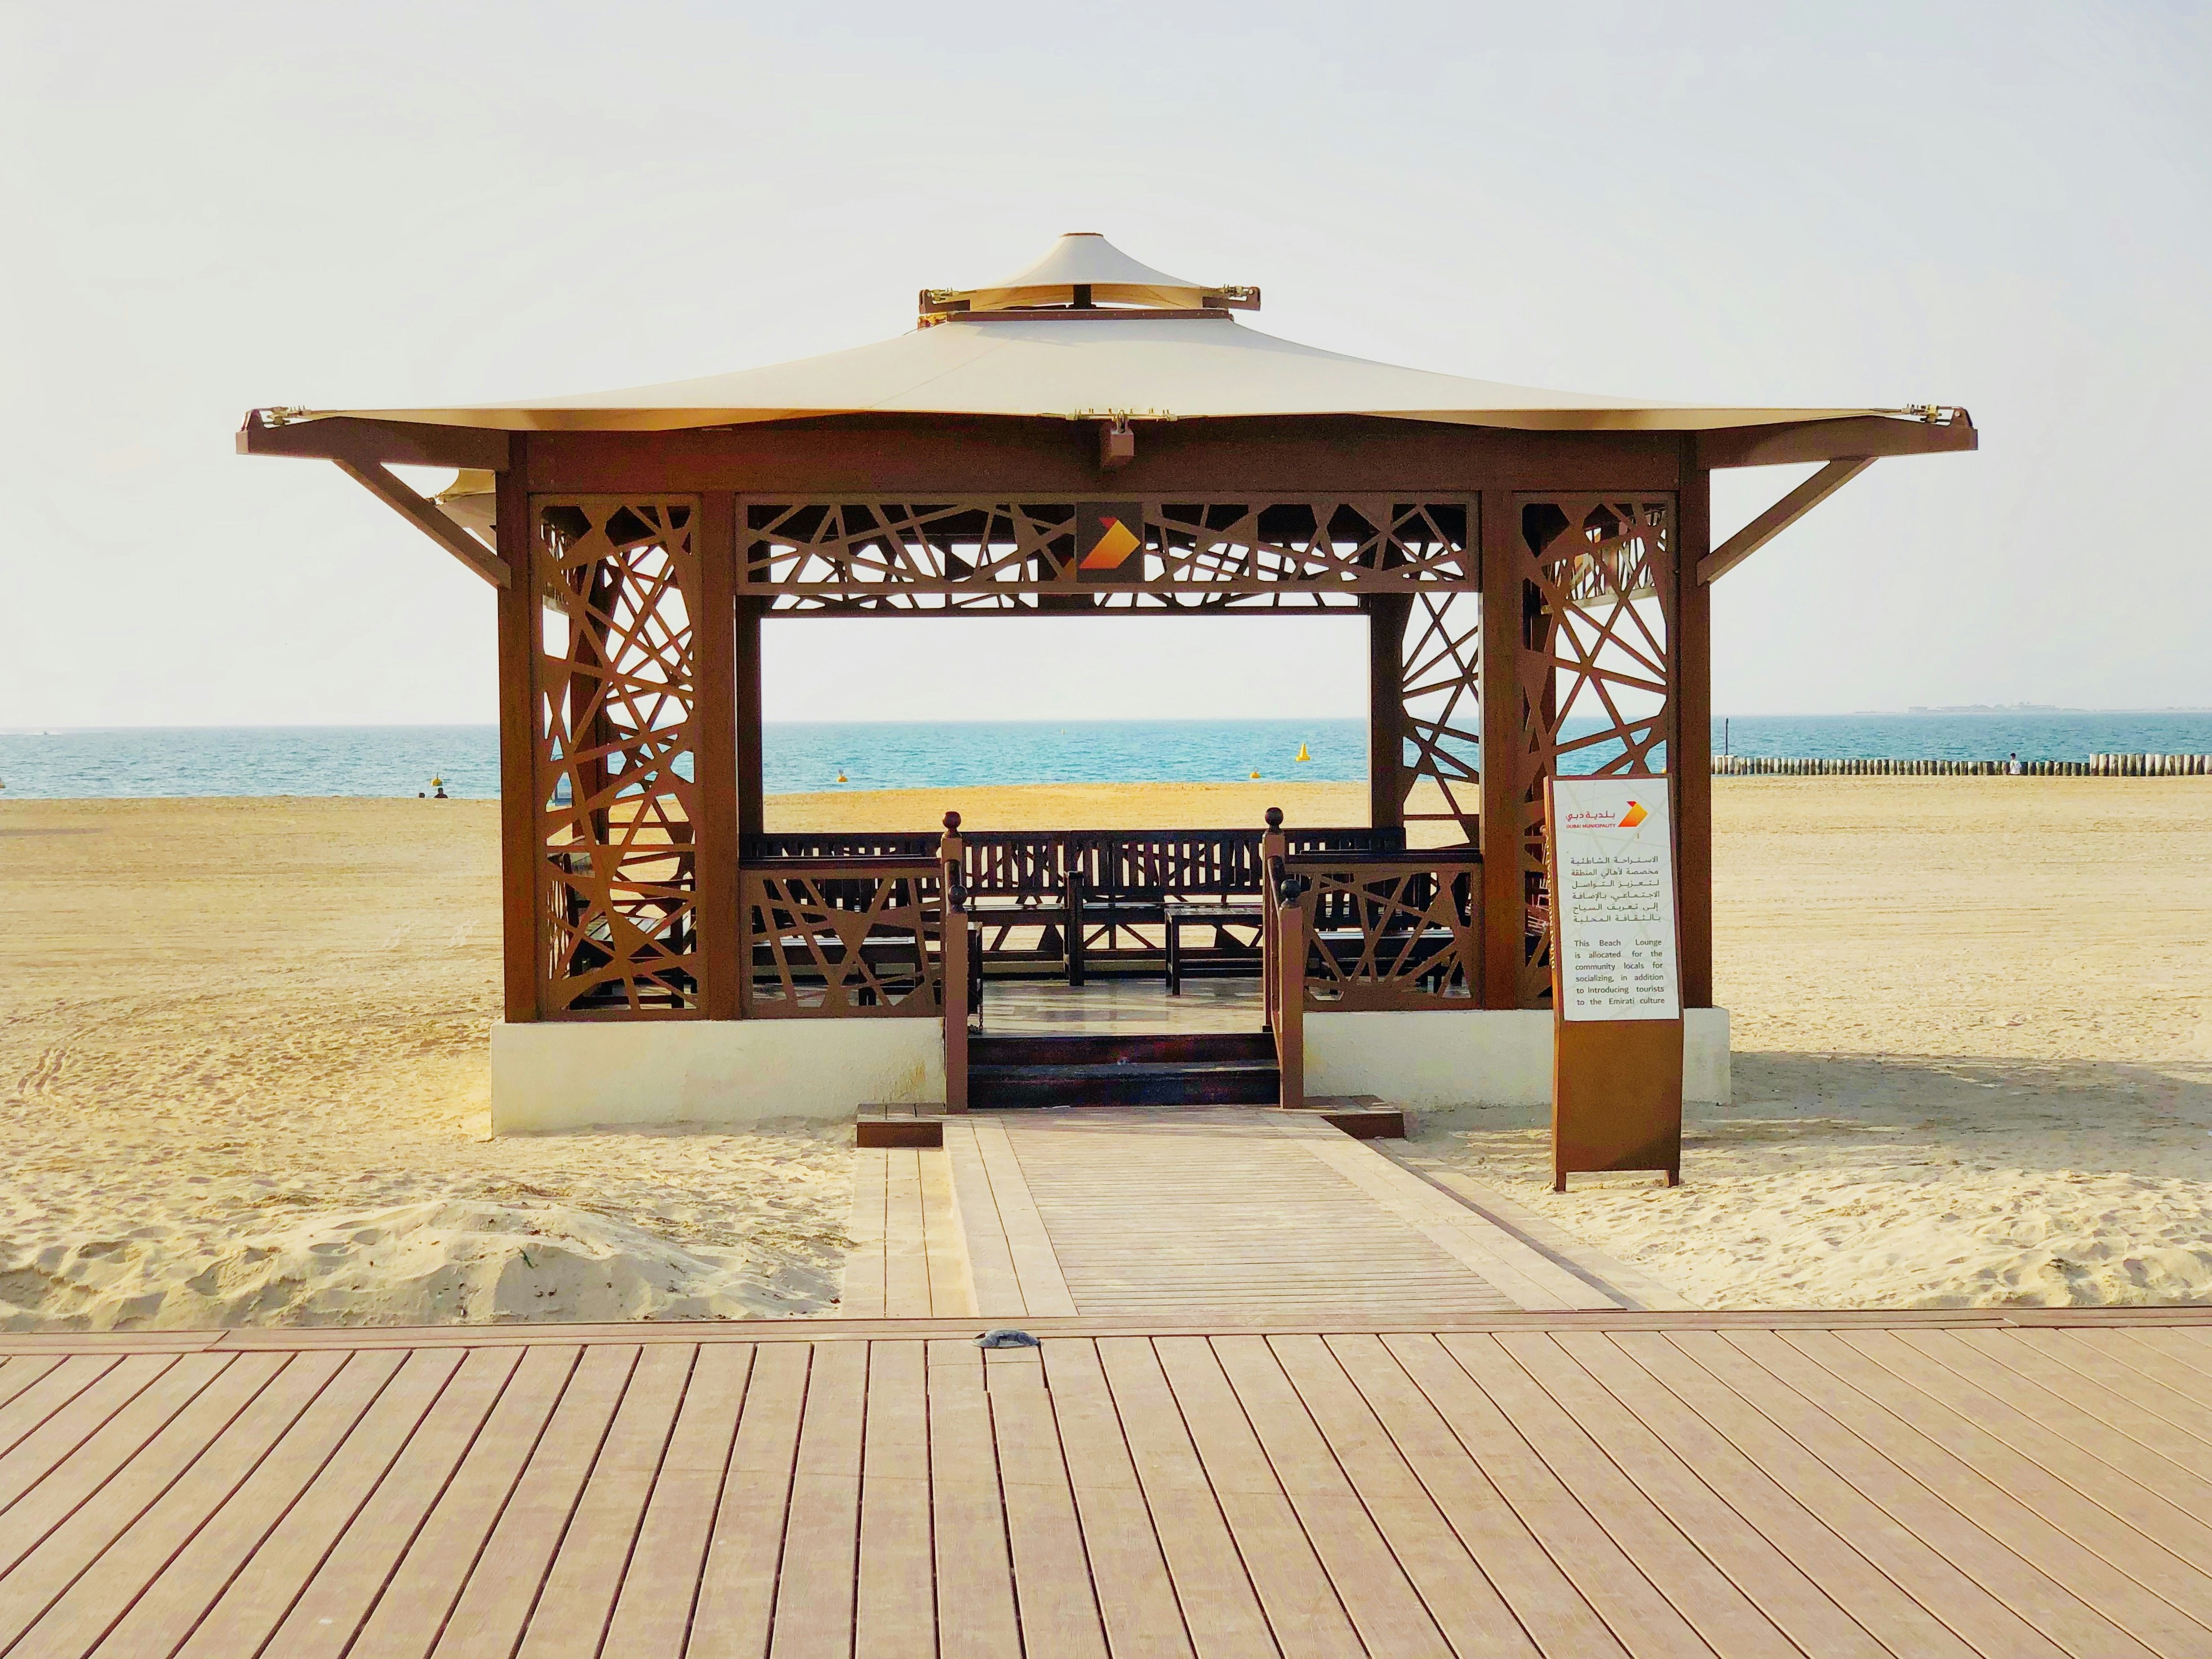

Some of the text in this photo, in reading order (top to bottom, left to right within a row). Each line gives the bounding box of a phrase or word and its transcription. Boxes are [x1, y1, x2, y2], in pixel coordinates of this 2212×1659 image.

[1566, 810, 1616, 822] بلدية دبي
[1570, 855, 1658, 866] الاستراحة الشاطئية
[1601, 867, 1623, 879] لأهالي
[1572, 879, 1659, 889] لتعزيز التواصل
[1572, 892, 1606, 901] بالإضافة
[1573, 903, 1602, 914] السياح
[1642, 902, 1658, 911] إلى
[1573, 915, 1611, 924] المحلية
